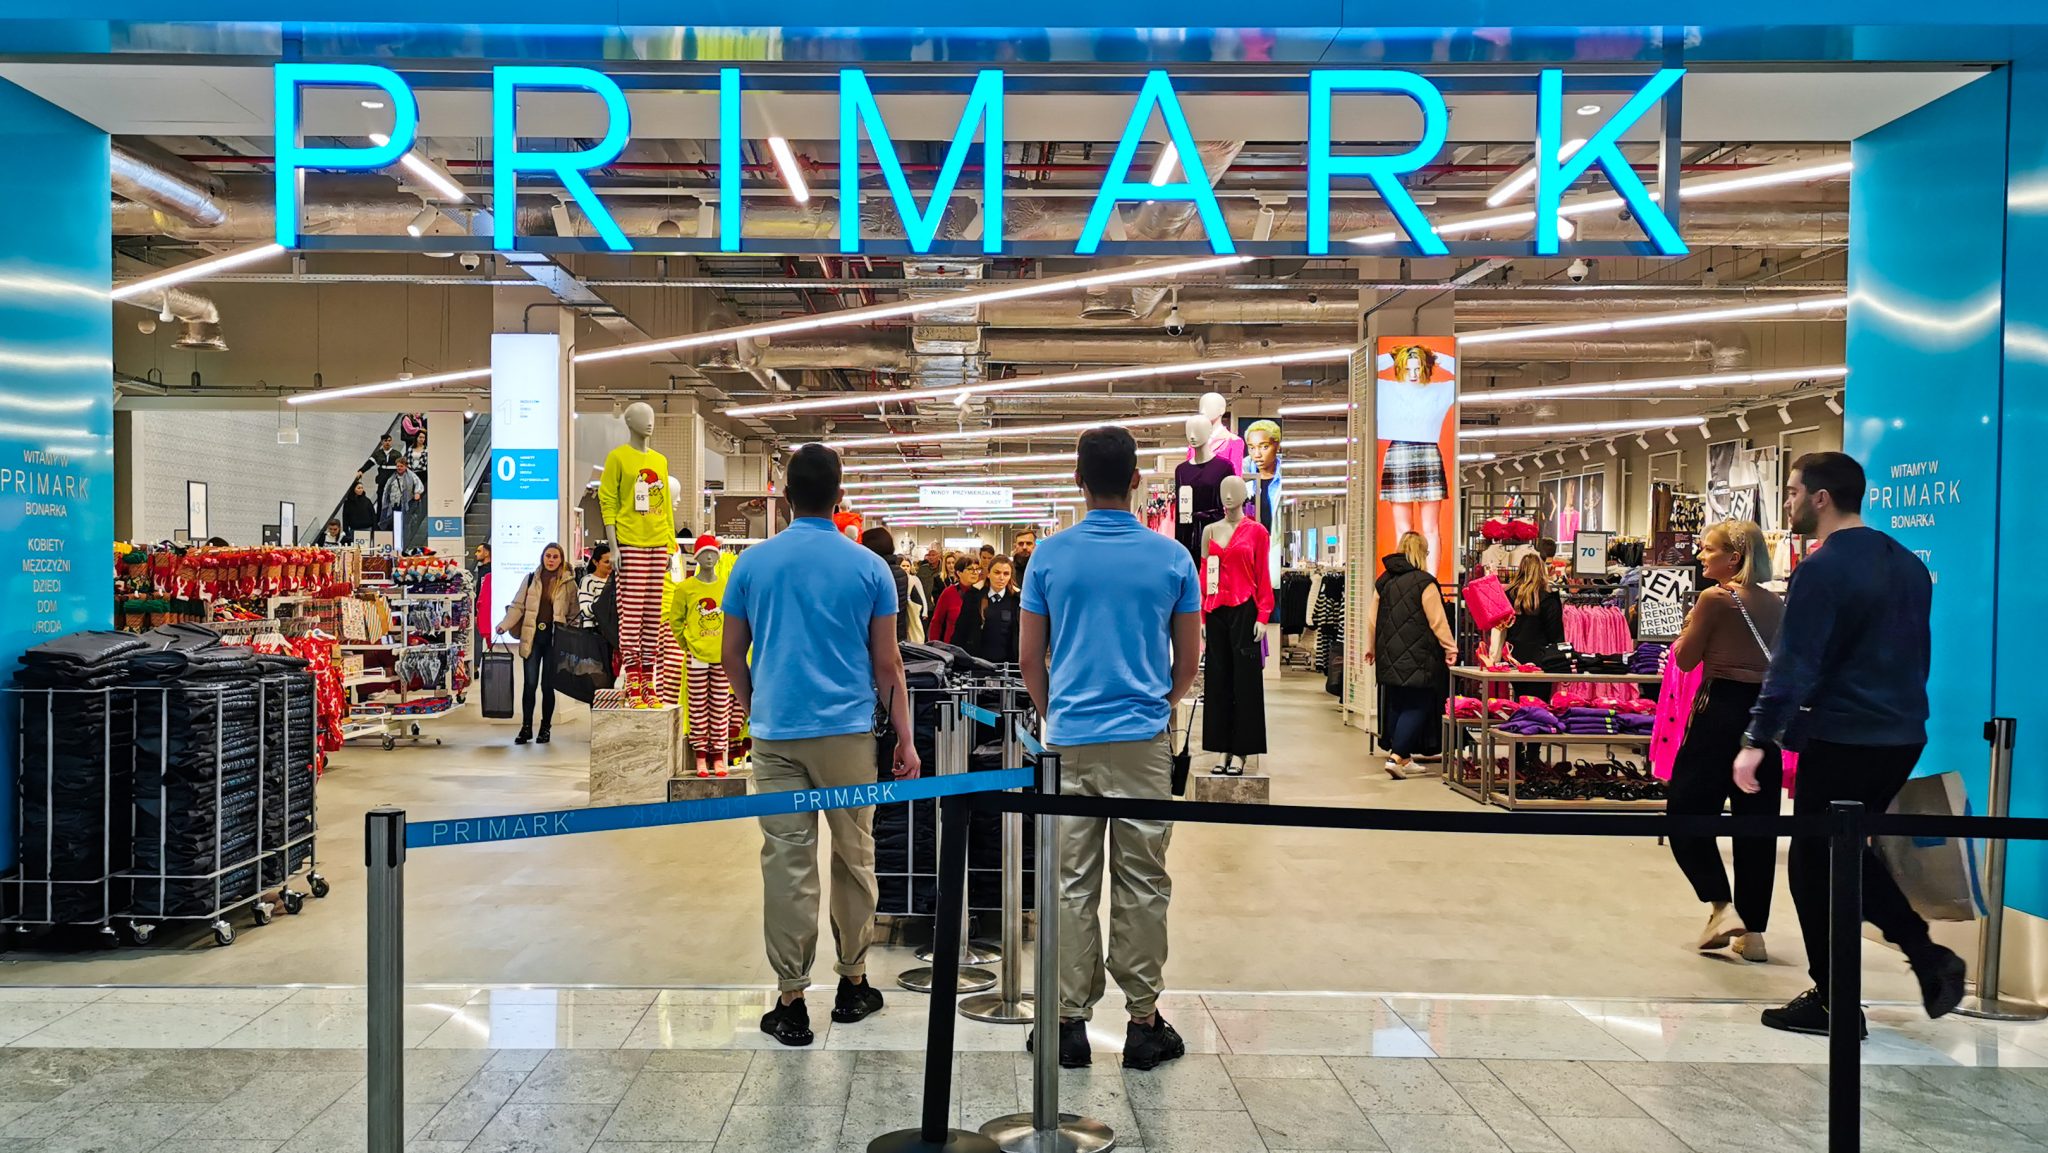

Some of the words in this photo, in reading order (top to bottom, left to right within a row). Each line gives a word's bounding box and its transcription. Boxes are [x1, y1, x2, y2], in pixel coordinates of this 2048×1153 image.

[274, 63, 1690, 255] PRIMARK
[23, 449, 58, 466] WITAMY
[497, 456, 516, 481] 0
[1891, 463, 1927, 479] WITAMY
[1929, 460, 1939, 475] W
[1, 468, 89, 499] PRIMARK
[1869, 479, 1961, 510] PRIMARK
[25, 501, 68, 518] BONARKA
[434, 519, 444, 532] 0
[1891, 513, 1936, 529] BONARKA
[27, 538, 65, 552] KOBIETY
[1580, 547, 1596, 557] 70
[33, 579, 61, 593] DZIECI
[37, 600, 57, 613] DOM
[32, 620, 63, 634] URODA
[794, 783, 896, 811] PRIMARK
[432, 792, 570, 845] PRIMARK
